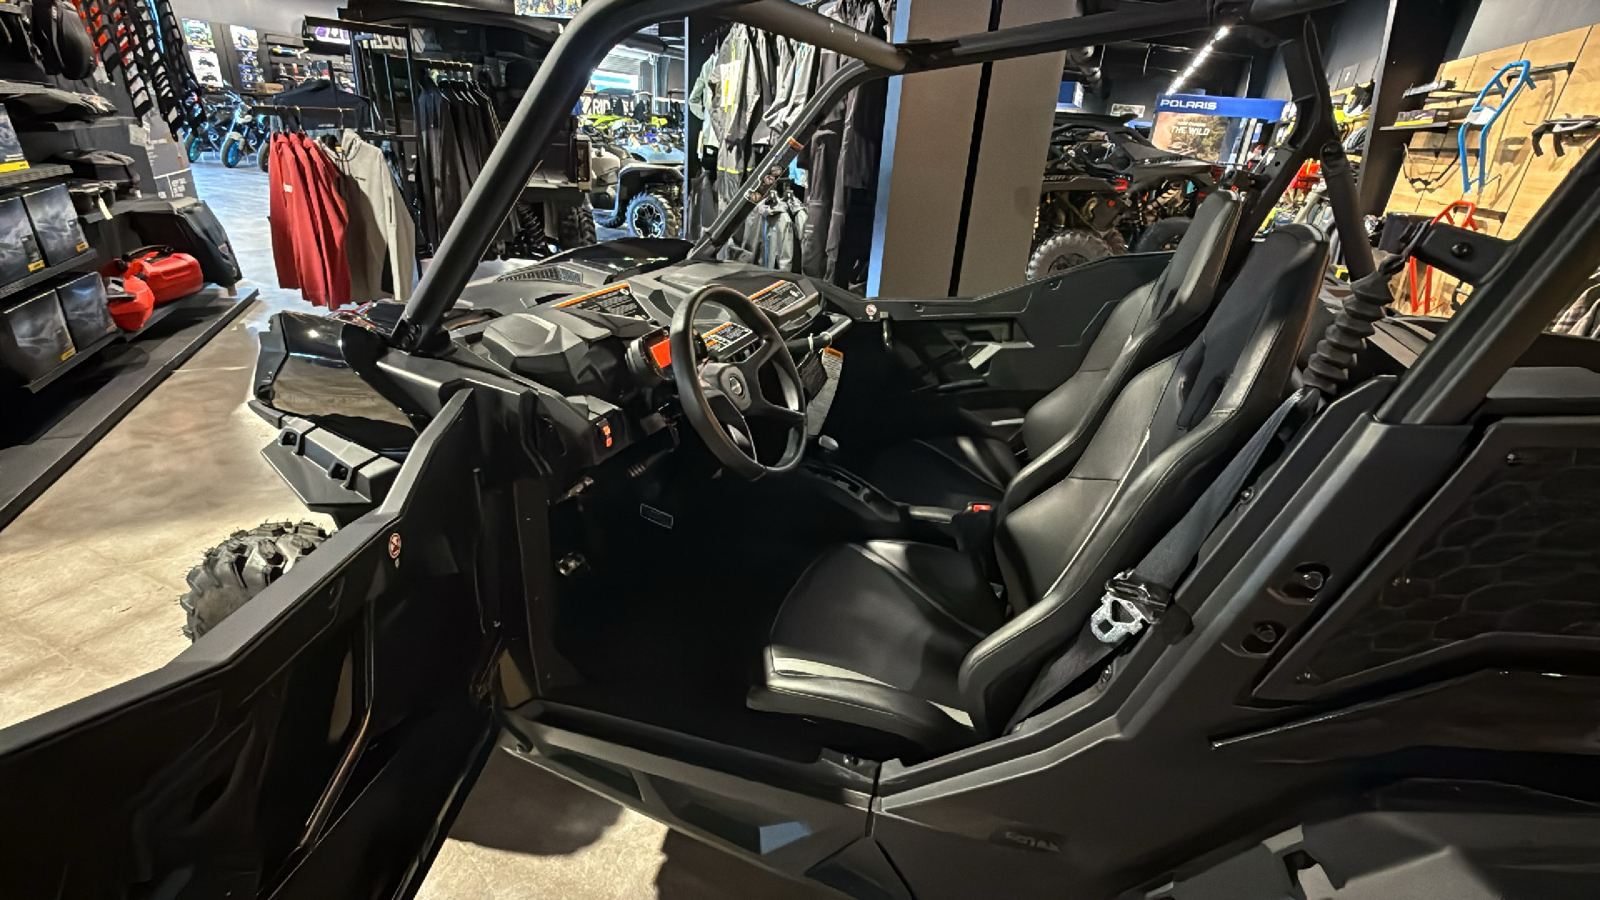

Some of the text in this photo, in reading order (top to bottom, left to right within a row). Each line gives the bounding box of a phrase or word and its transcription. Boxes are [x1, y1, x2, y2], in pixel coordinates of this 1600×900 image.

[1160, 99, 1217, 110] POLARIS
[1171, 125, 1210, 136] THE WILD
